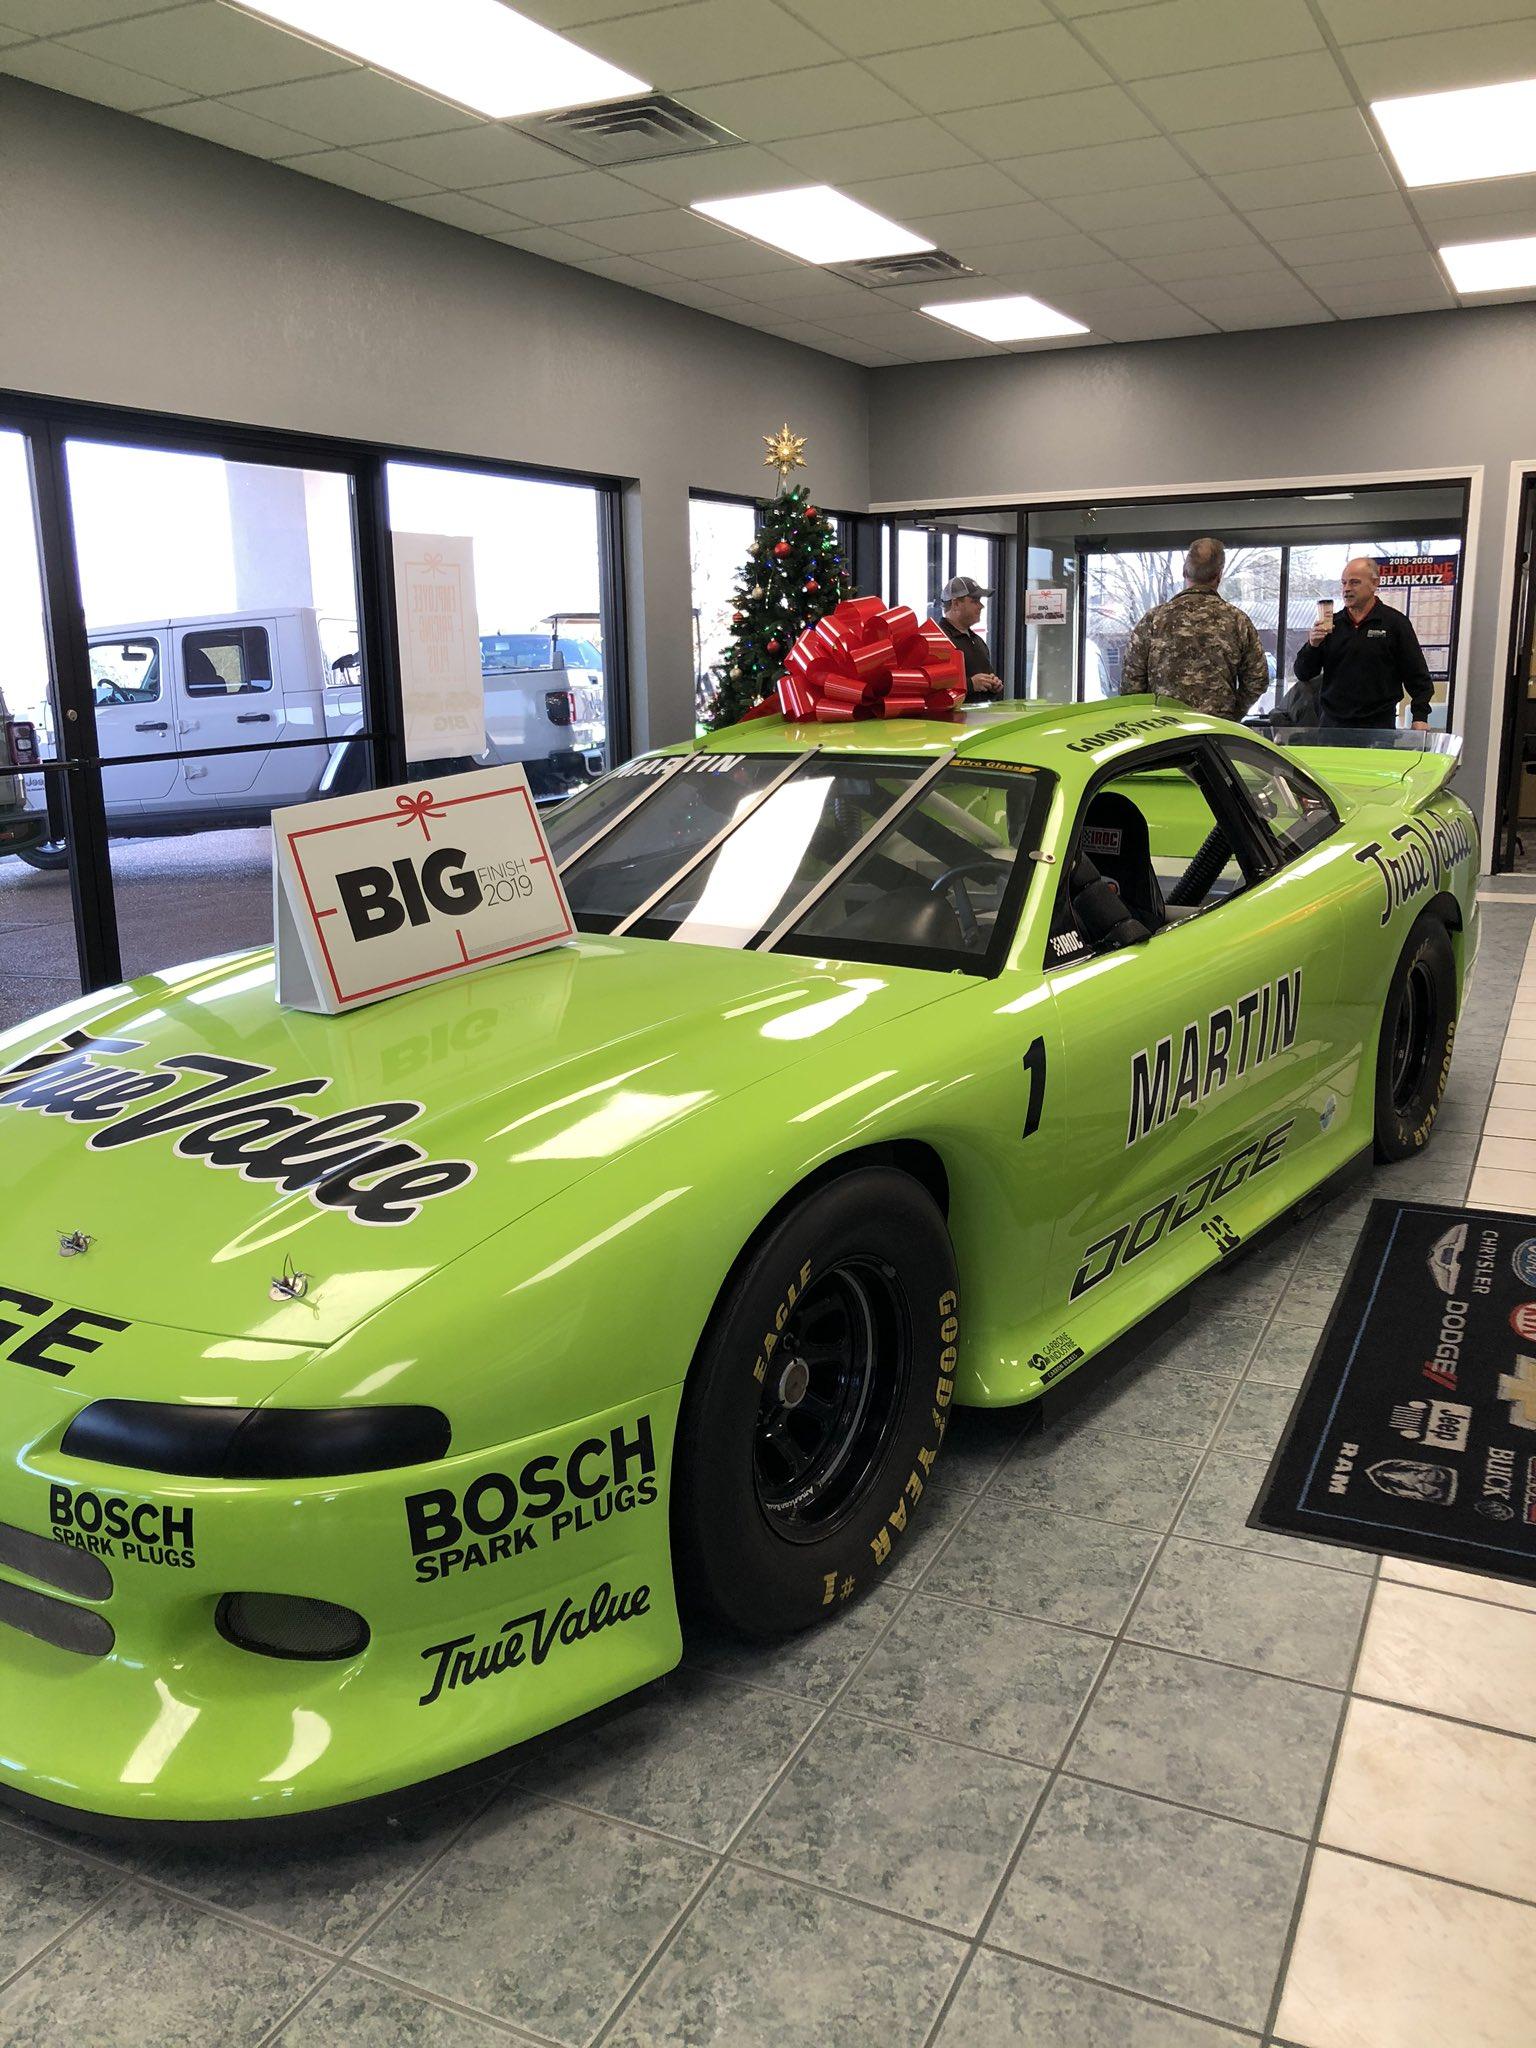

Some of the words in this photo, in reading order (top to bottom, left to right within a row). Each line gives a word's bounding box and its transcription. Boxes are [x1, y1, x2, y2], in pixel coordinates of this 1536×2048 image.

[1380, 574, 1443, 585] BEARKATZ
[1389, 557, 1434, 565] 2019-2020
[1065, 715, 1184, 752] GOODYEAR
[986, 762, 1022, 771] Glass
[335, 848, 484, 942] BIG
[477, 858, 528, 883] FINISH
[482, 875, 533, 907] 2019
[1354, 842, 1430, 928] True
[1055, 931, 1084, 956] IROC
[1022, 1035, 1047, 1139] 1
[1125, 967, 1302, 1149] MARTIN
[85, 1052, 478, 1227] Value
[1068, 1117, 1296, 1305] DODGE
[1472, 1230, 1498, 1295] CHRYSLER
[752, 1259, 812, 1385] EAGLE
[1042, 1331, 1071, 1355] CARBONE
[1432, 1300, 1469, 1374] DODGE
[1429, 1409, 1470, 1442] Jeep
[405, 1414, 656, 1556] BOSCH
[1328, 1441, 1360, 1496] RAM
[1482, 1446, 1517, 1501] BUICK
[50, 1484, 194, 1549] BOSCH
[52, 1526, 115, 1557] SPARK
[122, 1541, 196, 1569] PLUGS
[415, 1523, 538, 1583] SPARK
[551, 1476, 658, 1541] PLUGS
[419, 1632, 527, 1706] True
[501, 1582, 651, 1665] Value
